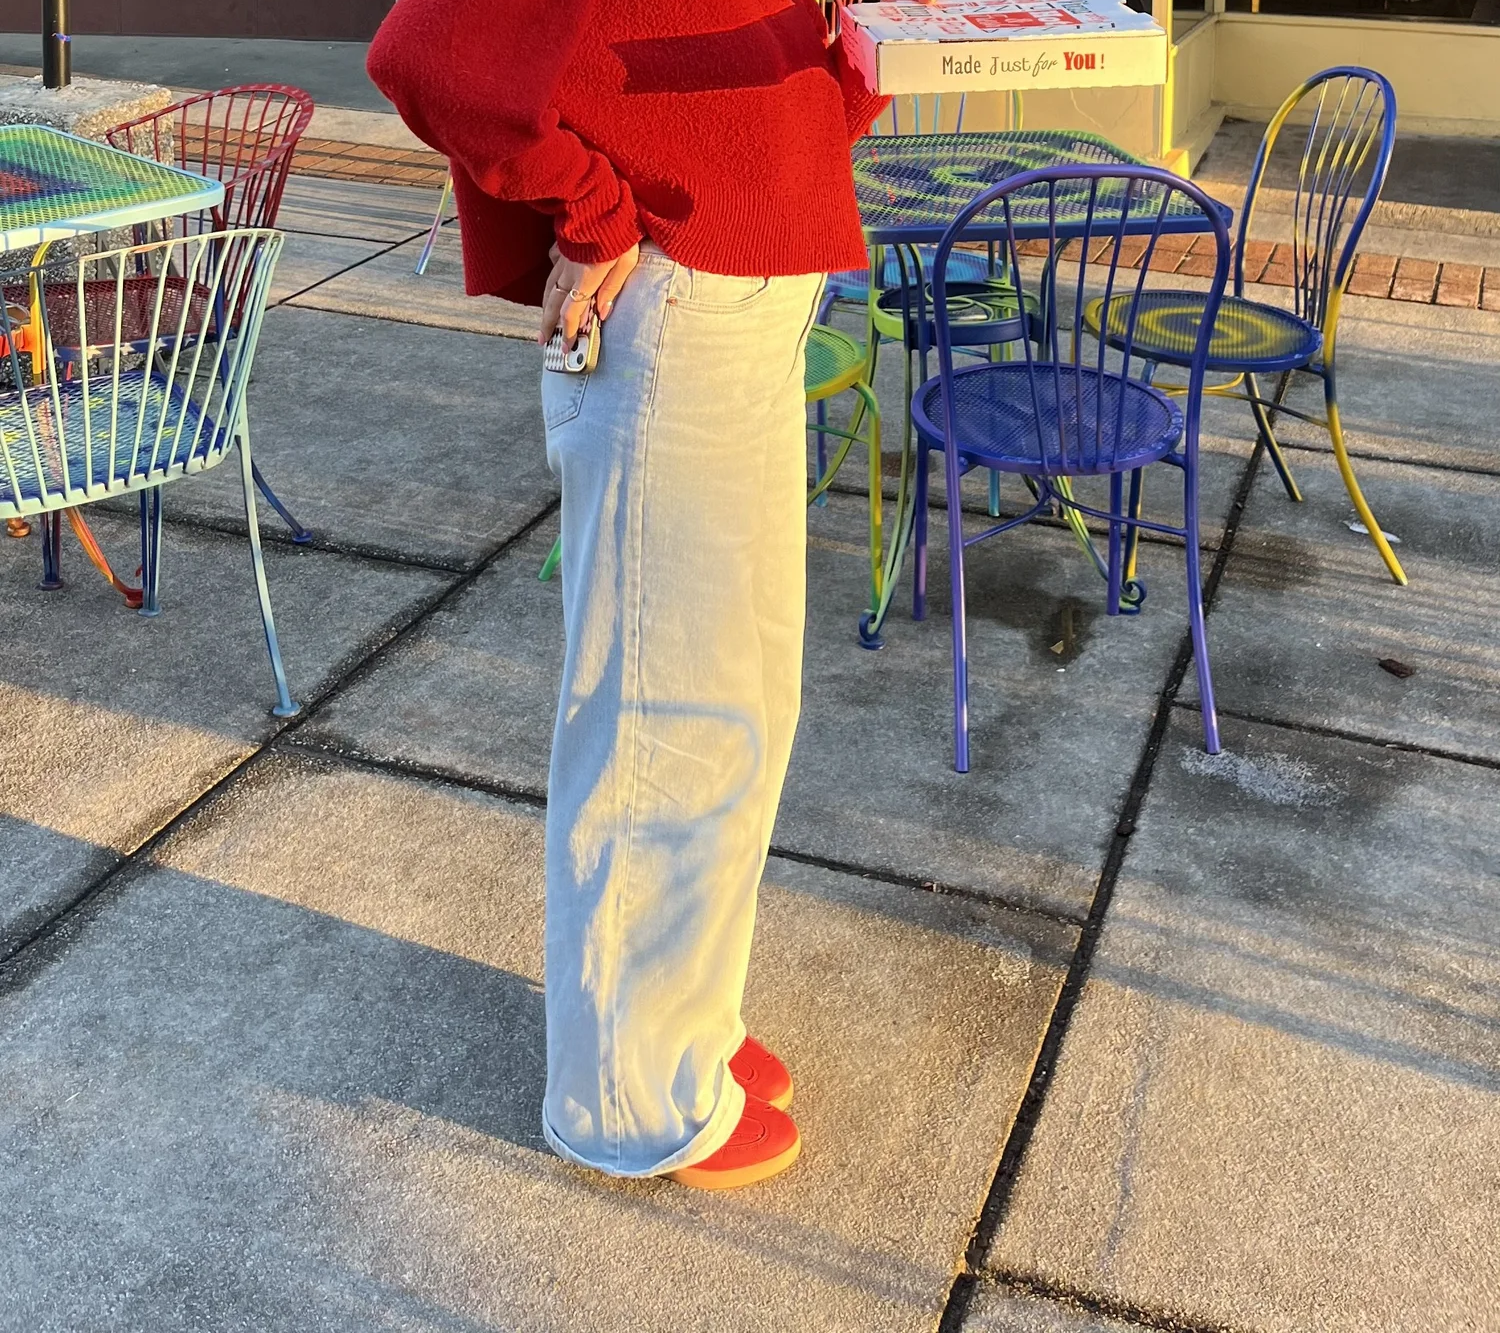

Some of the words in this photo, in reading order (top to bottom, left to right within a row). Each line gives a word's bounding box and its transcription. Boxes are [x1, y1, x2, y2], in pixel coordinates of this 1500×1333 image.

[942, 55, 981, 76] Made
[989, 52, 1031, 76] Just
[1032, 51, 1058, 78] for
